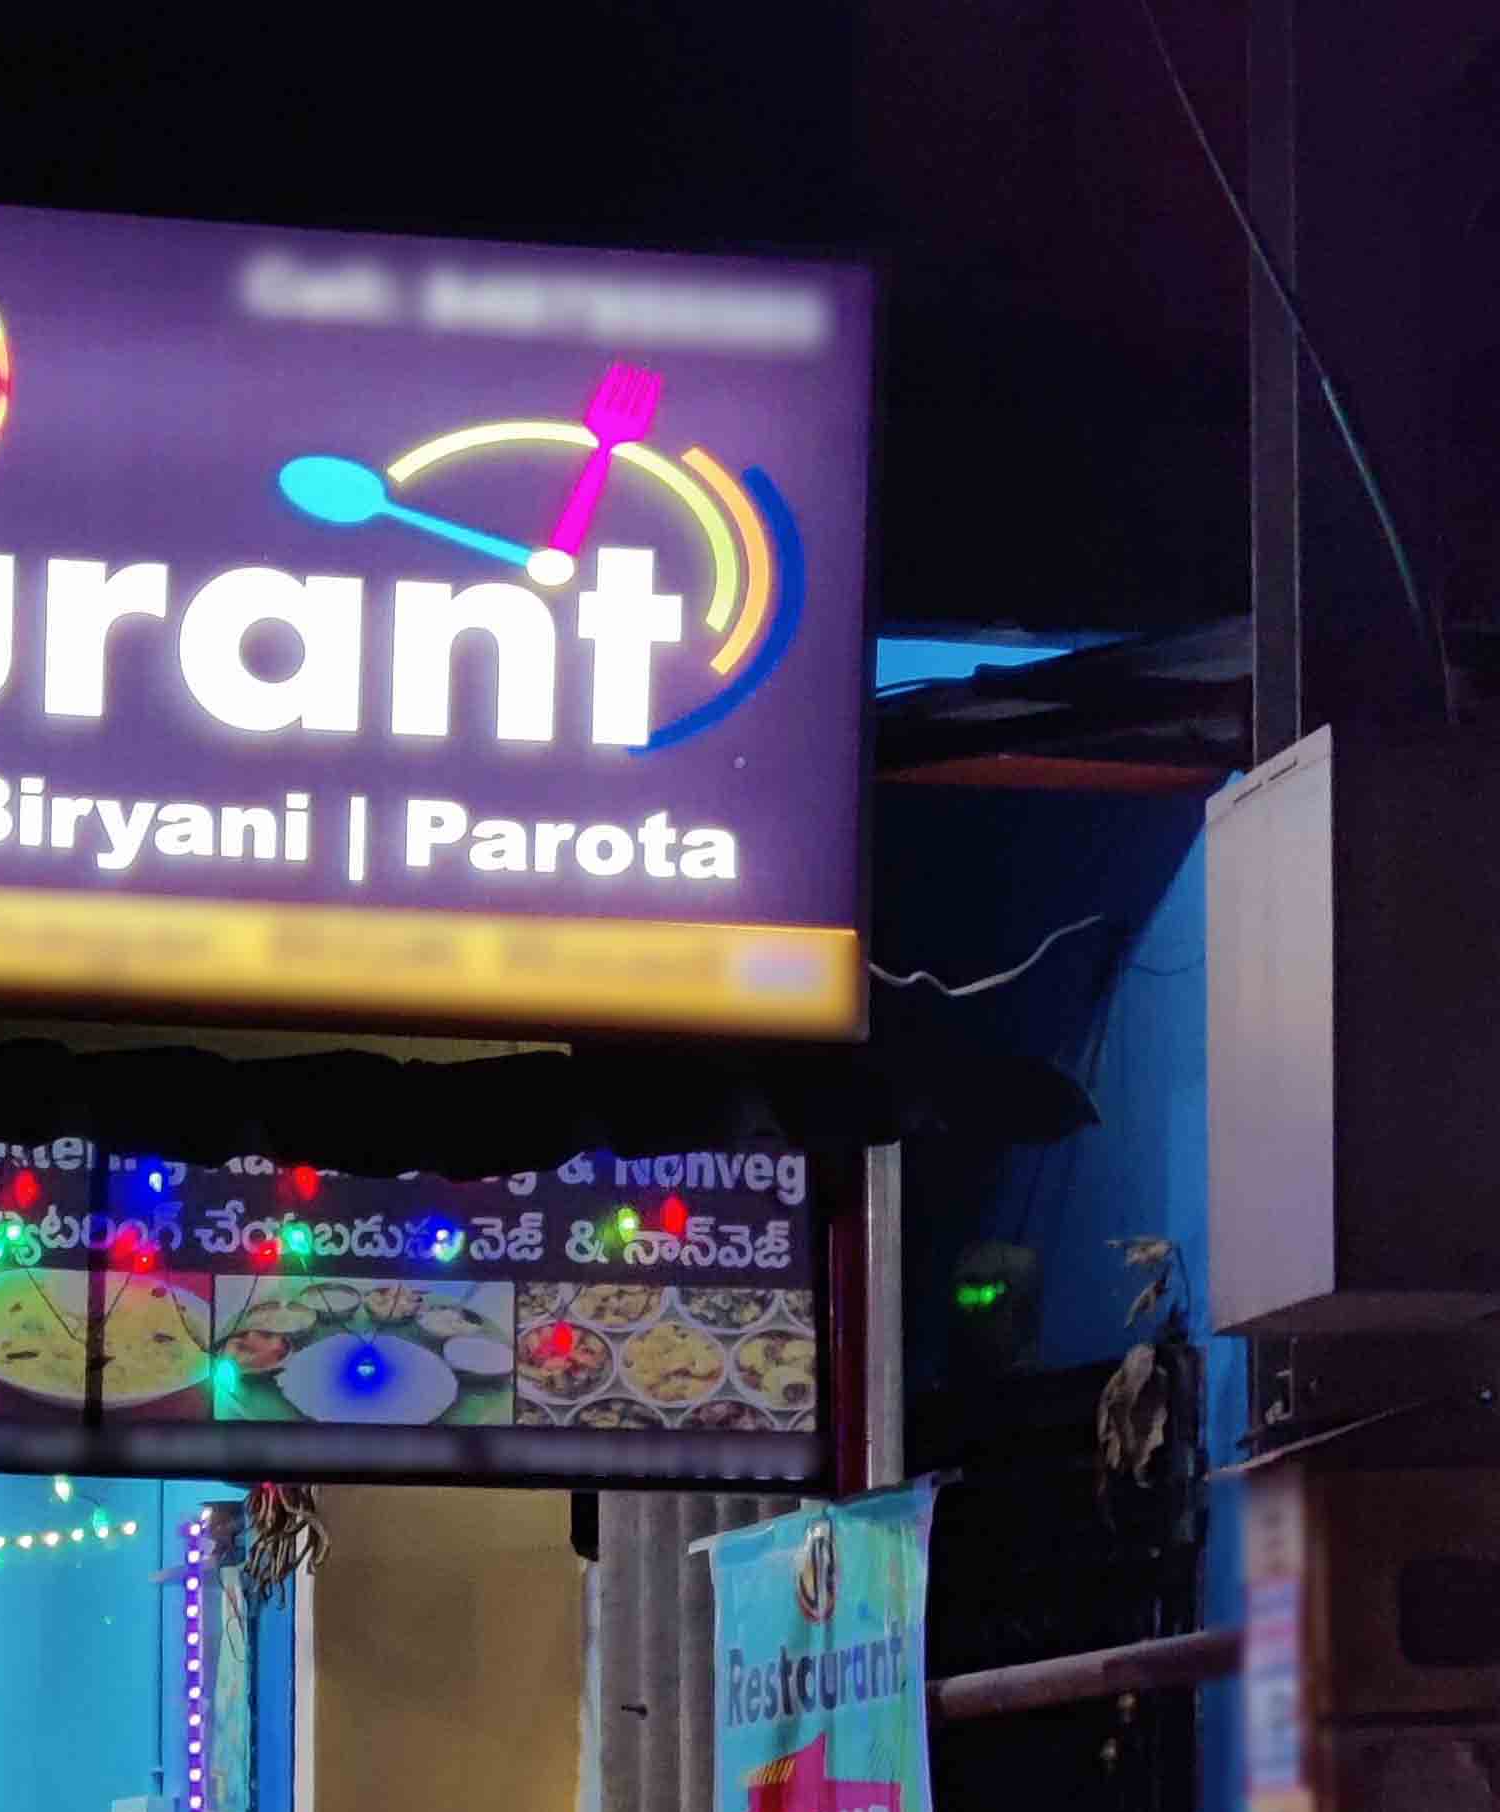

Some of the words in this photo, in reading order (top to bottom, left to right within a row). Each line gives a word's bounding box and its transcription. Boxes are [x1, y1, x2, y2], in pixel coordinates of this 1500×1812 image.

[403, 799, 737, 880] Parota
[564, 1219, 608, 1265] &
[725, 1636, 903, 1729] Restaurant
